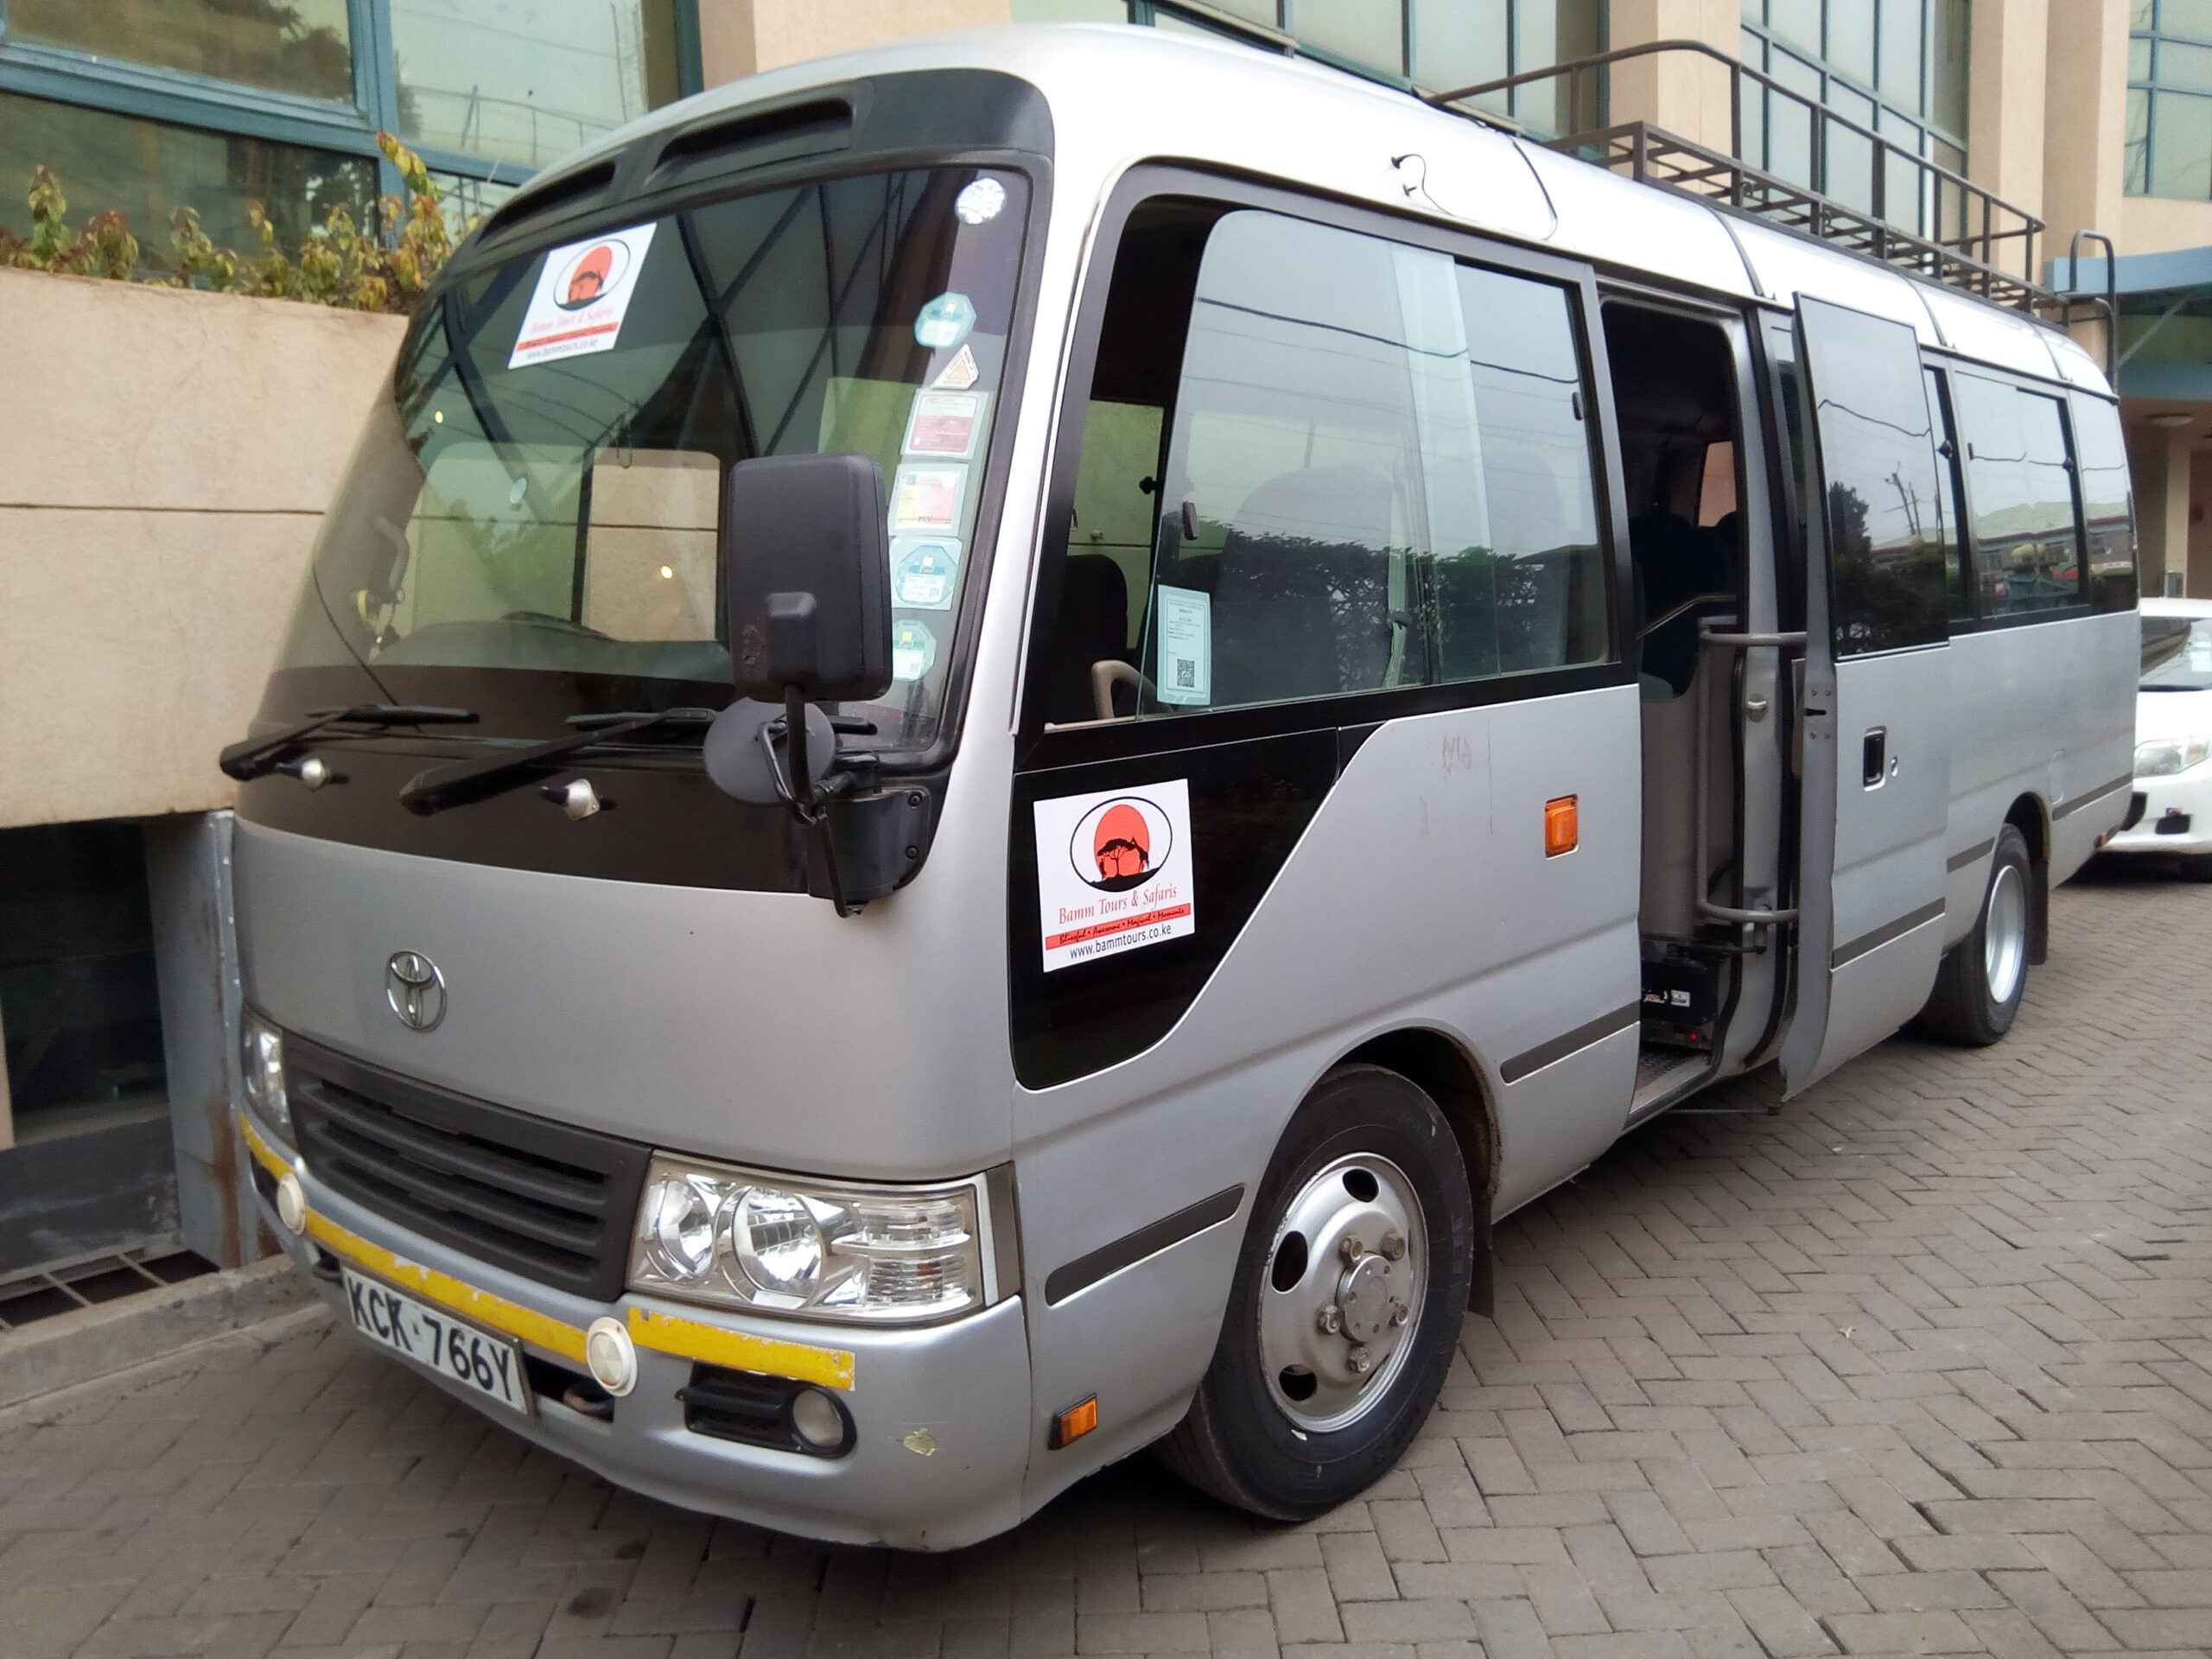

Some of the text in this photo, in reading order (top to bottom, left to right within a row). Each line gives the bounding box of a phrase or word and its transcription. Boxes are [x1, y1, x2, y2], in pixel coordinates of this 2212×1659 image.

[1058, 883, 1178, 924] Bamm Tours & Safaris
[1070, 924, 1172, 959] www.bammtours.co.ke
